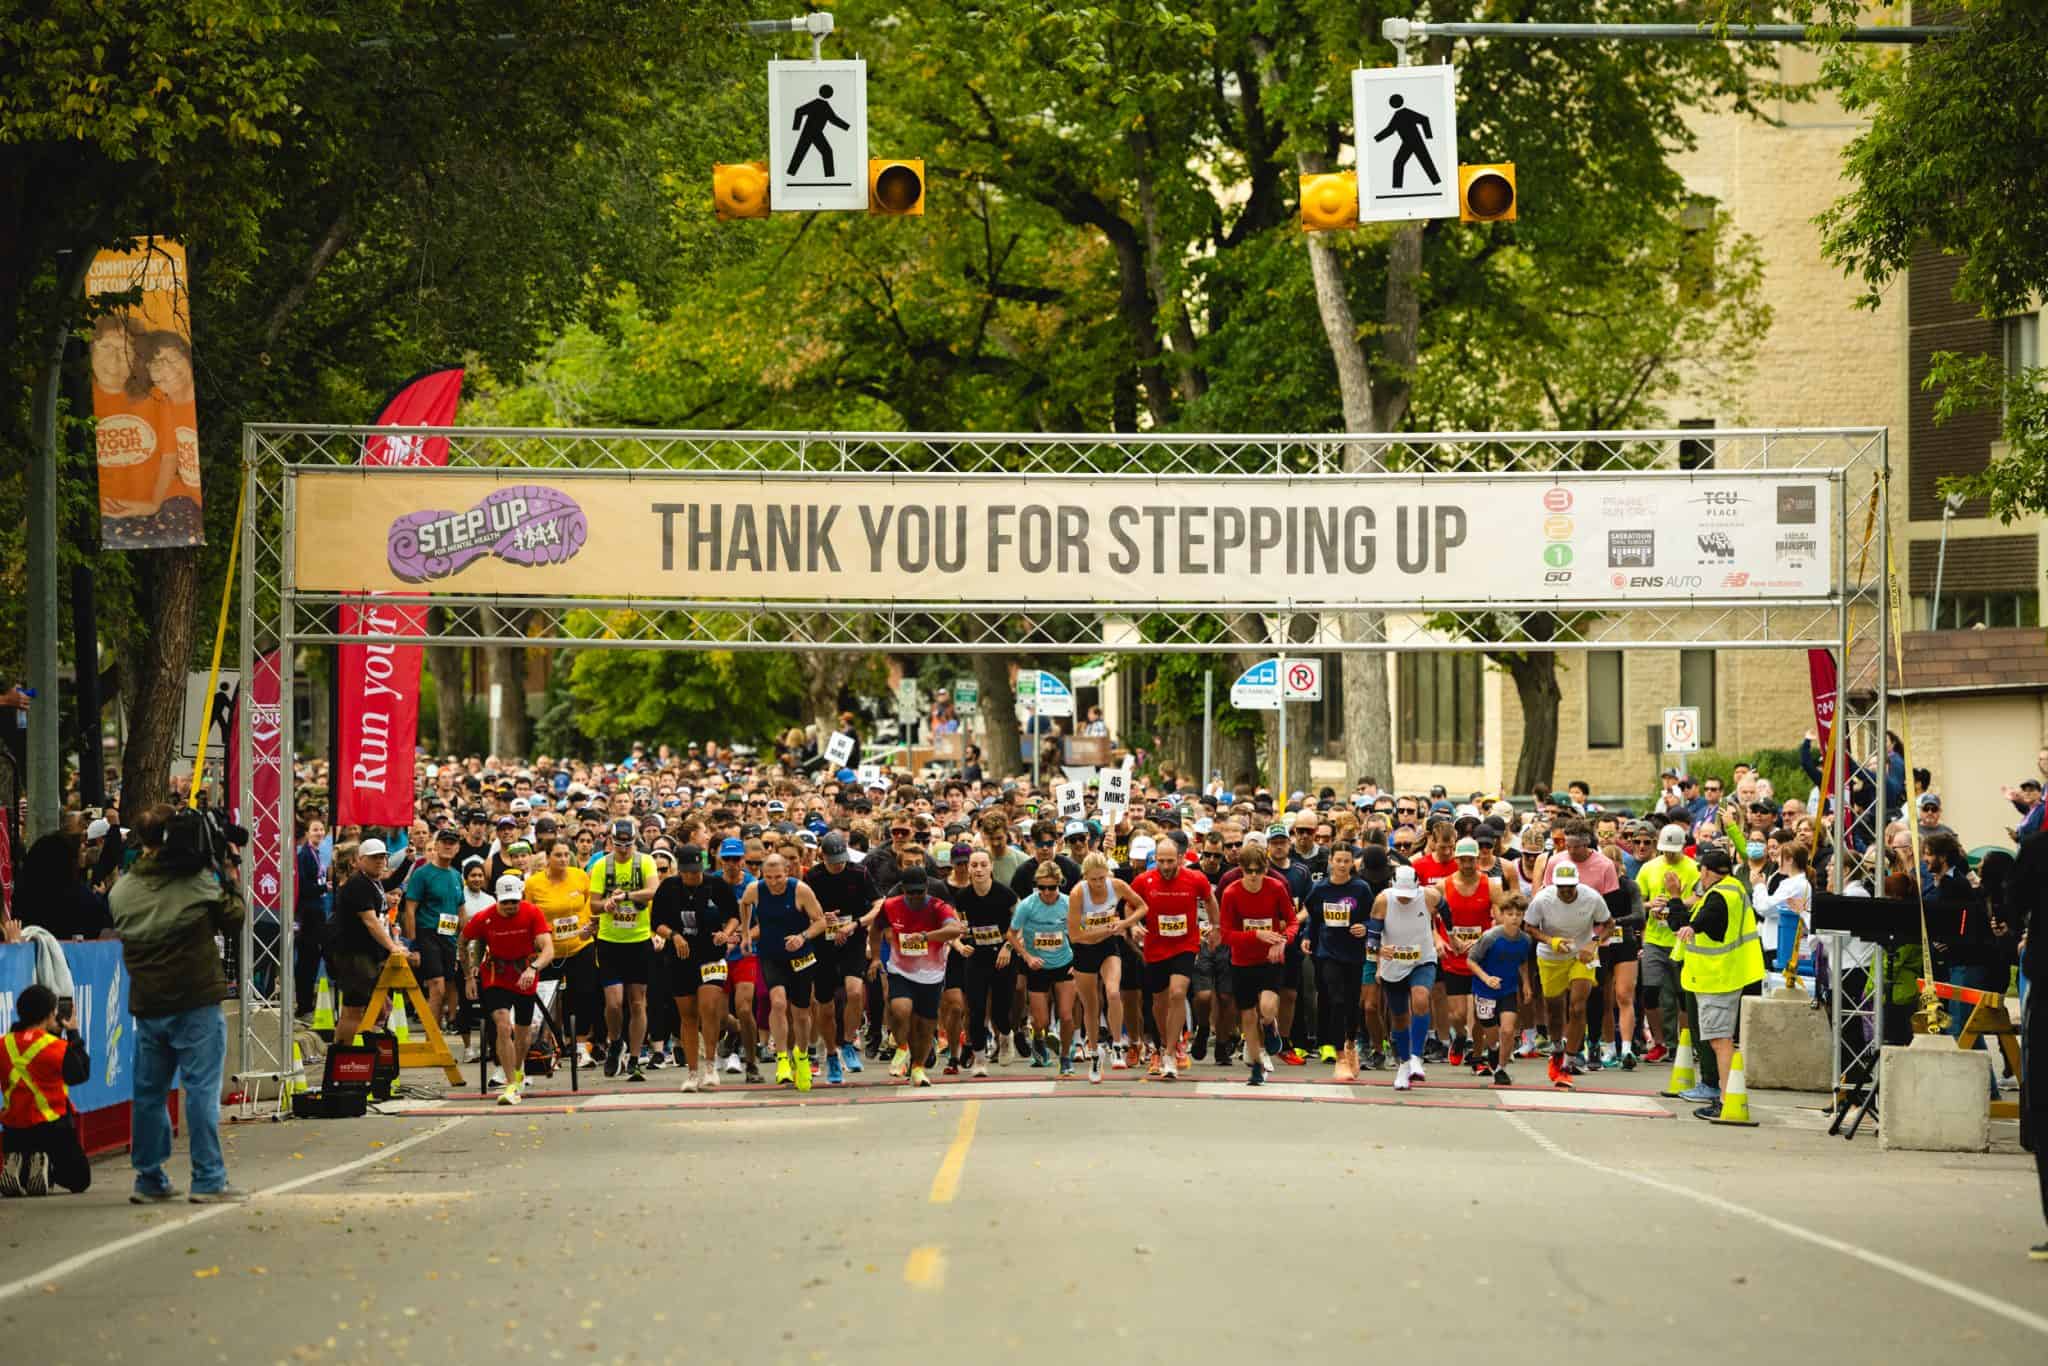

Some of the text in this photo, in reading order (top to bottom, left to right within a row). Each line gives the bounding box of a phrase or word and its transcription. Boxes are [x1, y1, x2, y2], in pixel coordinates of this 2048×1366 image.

[1704, 491, 1738, 505] TCU
[418, 498, 528, 553] STEP UP
[651, 503, 1467, 575] THANK YOU FOR STEPPING UP
[1545, 572, 1572, 582] GO
[1630, 576, 1702, 588] ENS AUTO
[353, 711, 389, 793] Run
[1110, 776, 1121, 788] 45
[1066, 789, 1076, 800] 50
[1104, 791, 1126, 804] MINS
[1063, 802, 1081, 815] MINS
[1161, 921, 1185, 931] 7567
